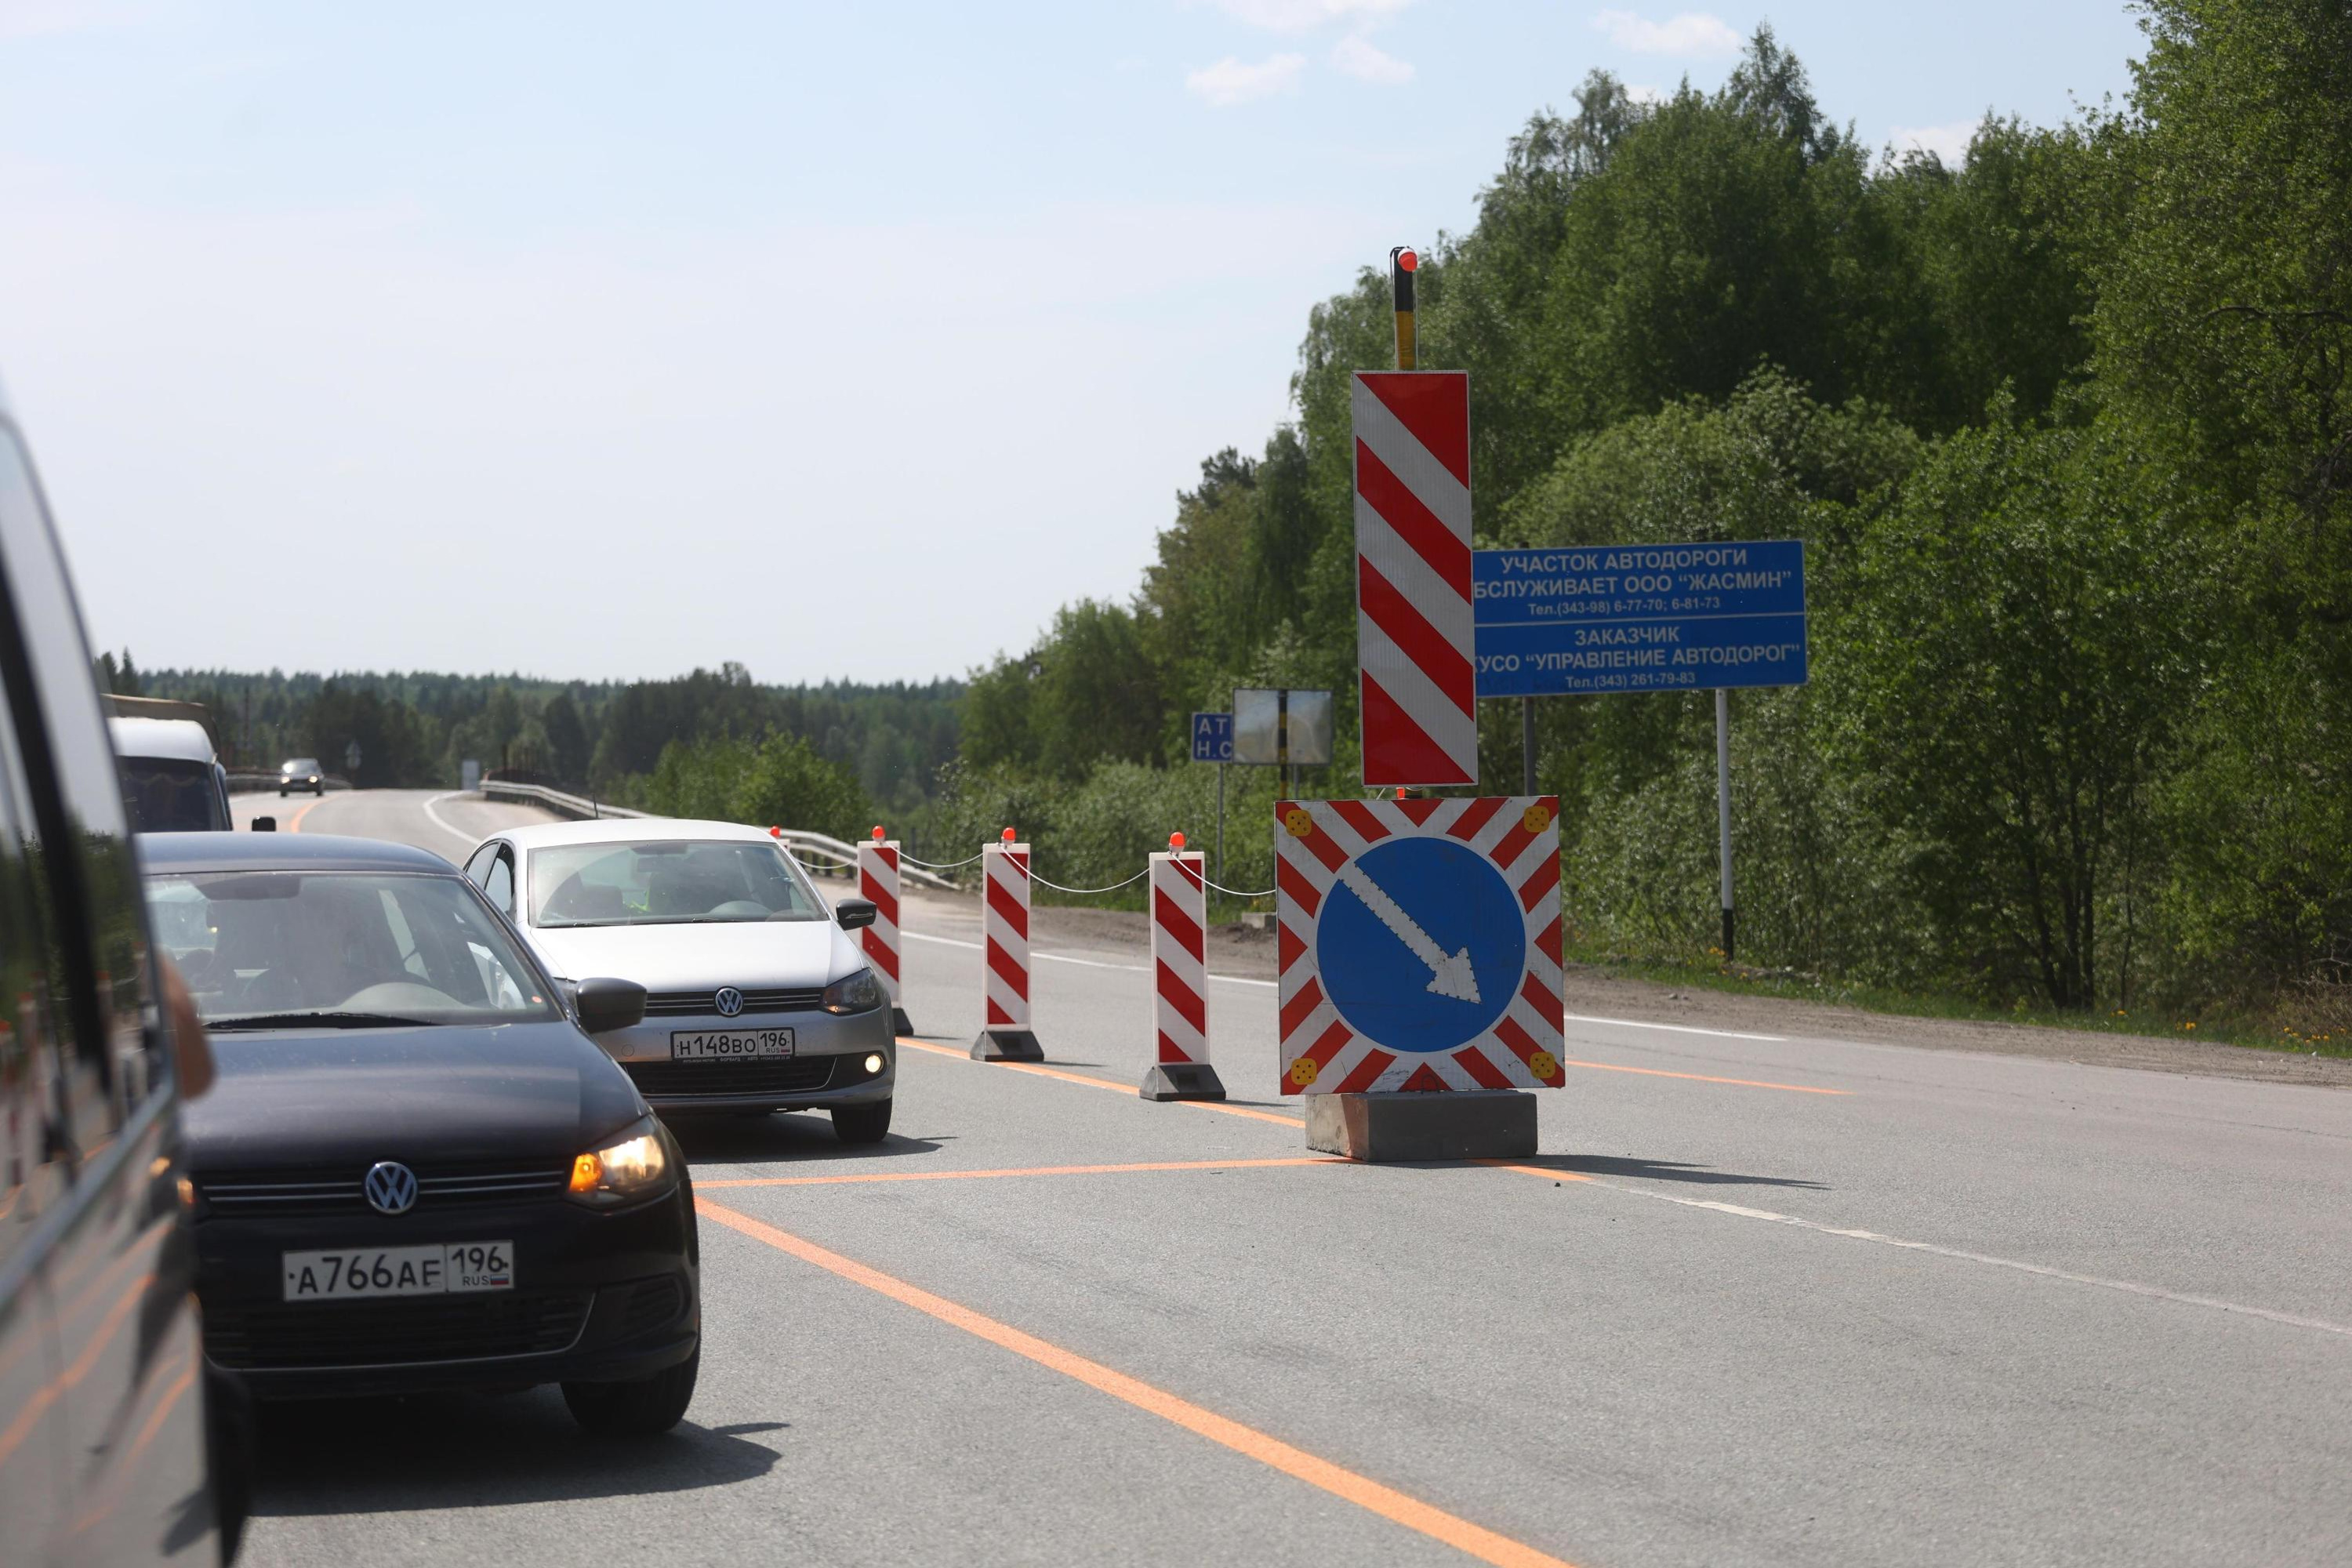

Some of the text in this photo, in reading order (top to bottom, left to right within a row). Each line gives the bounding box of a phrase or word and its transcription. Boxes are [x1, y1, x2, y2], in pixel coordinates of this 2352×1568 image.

[1501, 549, 1748, 575] УЧАСТОК АВТОДОРОГИ
[1474, 577, 1619, 599] БСЛУЖИВАЕТ
[1624, 575, 1672, 593] ООО
[1528, 596, 1721, 618] Тел.(343-98) 6-77-70; 6-81-73
[1574, 626, 1680, 647] ЗАКАЗЧИК
[1475, 654, 1521, 673] УСО
[1565, 671, 1697, 690] Тел.(343) 261-79-83
[760, 1031, 788, 1047] 196
[451, 1245, 506, 1274] 196
[463, 1275, 490, 1287] RUS
